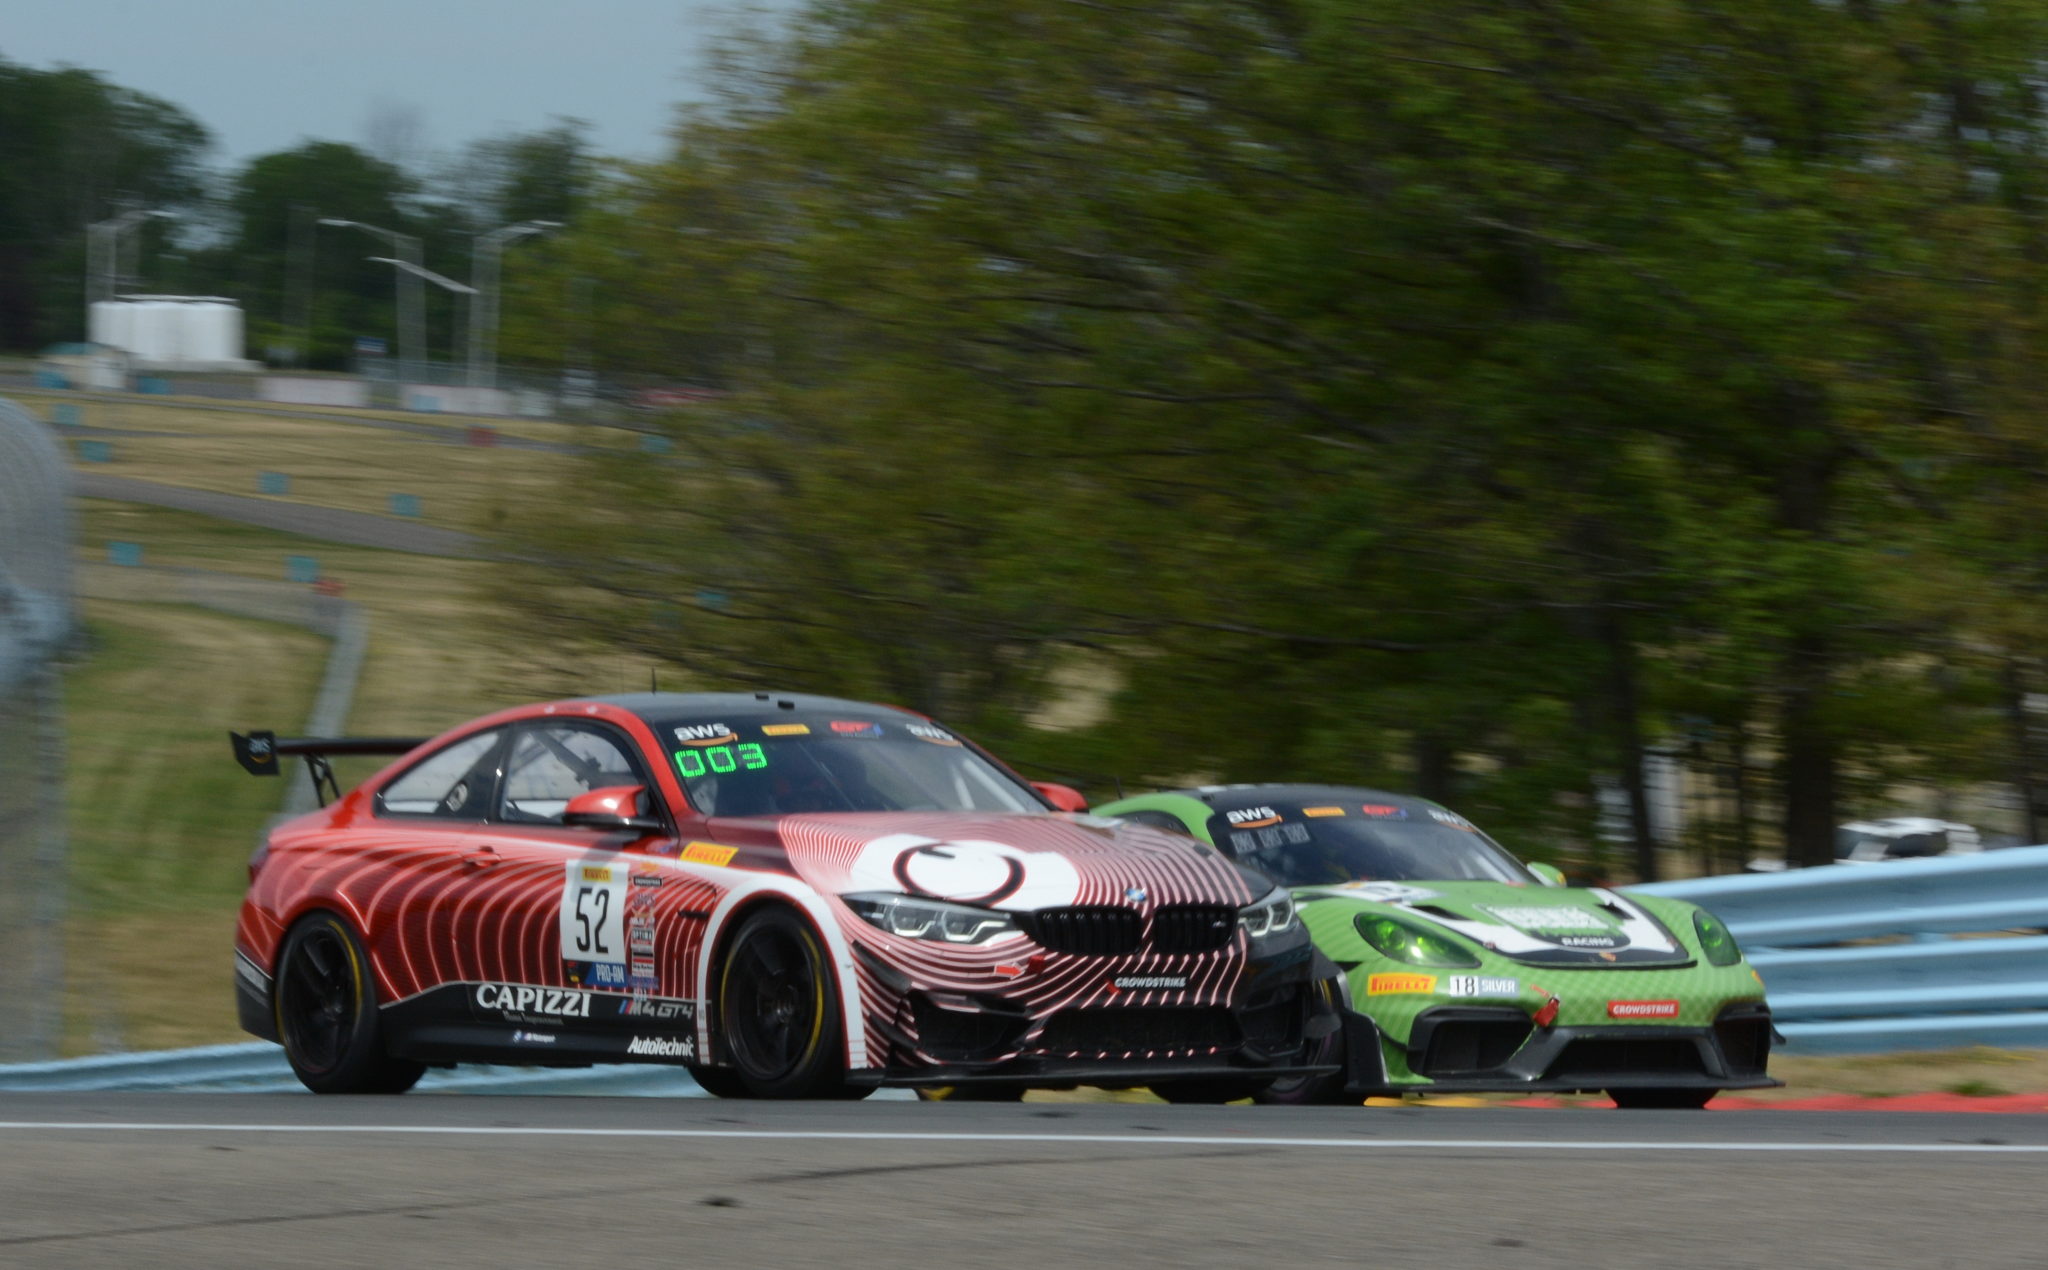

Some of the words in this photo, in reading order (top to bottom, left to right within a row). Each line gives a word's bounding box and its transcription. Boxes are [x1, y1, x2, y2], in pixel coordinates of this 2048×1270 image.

[674, 723, 731, 742] aws
[674, 743, 768, 778] 003
[1226, 806, 1277, 825] aws
[575, 887, 609, 954] 52
[1115, 976, 1187, 988] CROWDSTRIKE
[1371, 975, 1431, 993] PIRELLI
[1455, 976, 1475, 996] 18
[1481, 978, 1517, 993] SILVER
[476, 983, 592, 1018] CAPIZZI
[1612, 1003, 1675, 1016] CROWDSTRIKE
[626, 1035, 694, 1057] AutoTechnic
